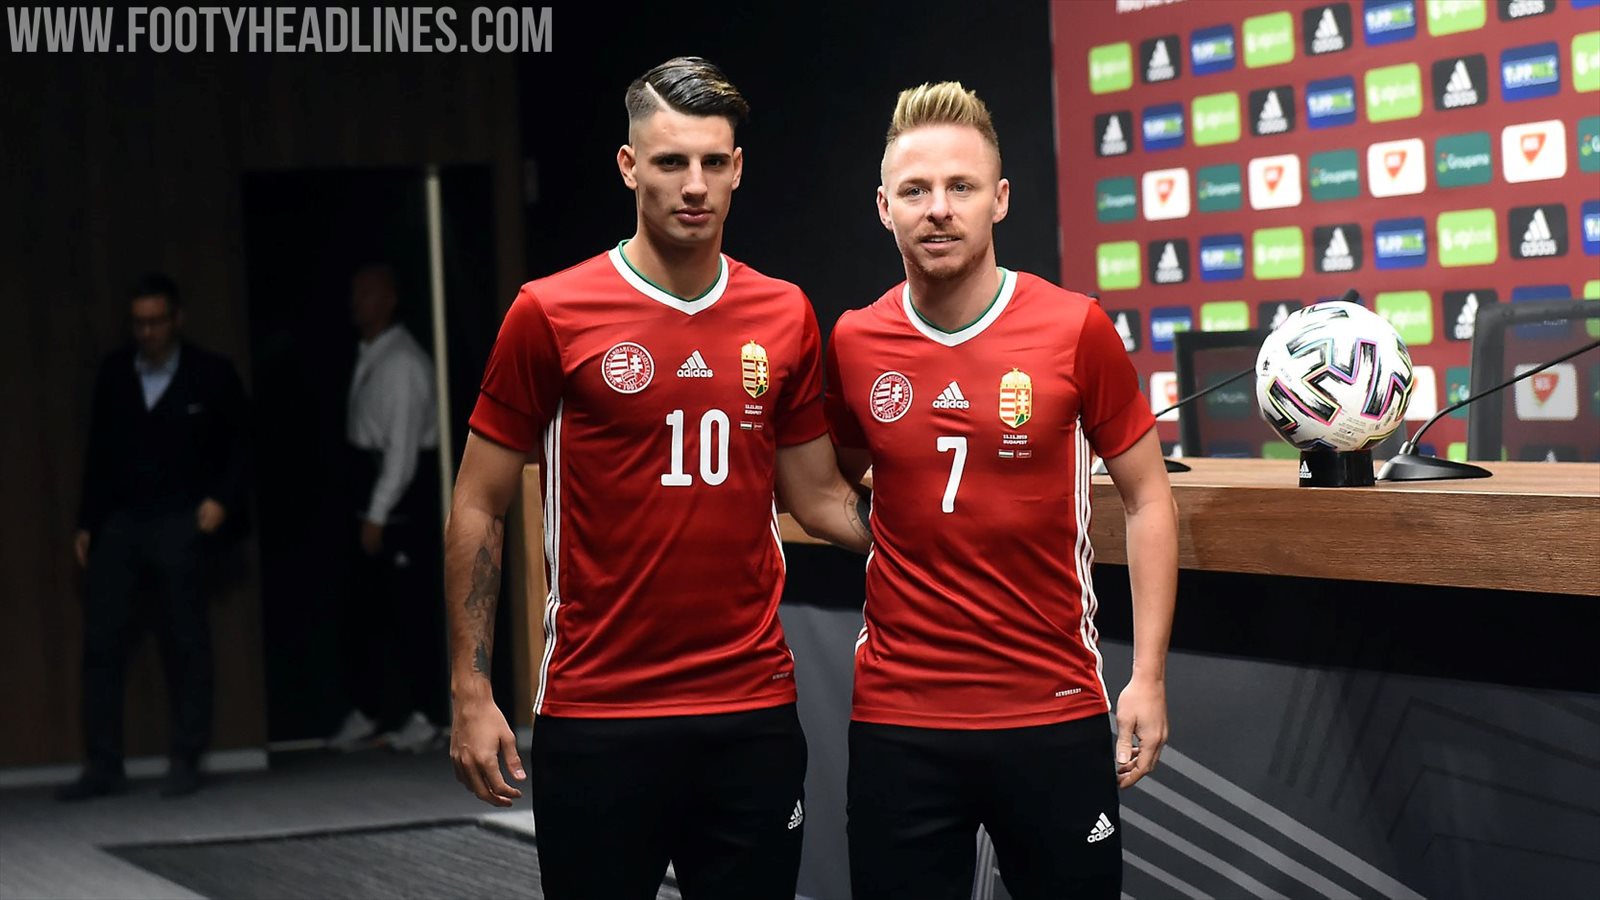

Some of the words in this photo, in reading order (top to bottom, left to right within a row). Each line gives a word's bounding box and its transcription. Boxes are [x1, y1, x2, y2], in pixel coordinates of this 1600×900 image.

[676, 367, 714, 378] adidas
[932, 399, 970, 410] adidas
[660, 409, 730, 487] 10
[936, 436, 968, 514] 7
[1087, 825, 1115, 843] adidas
